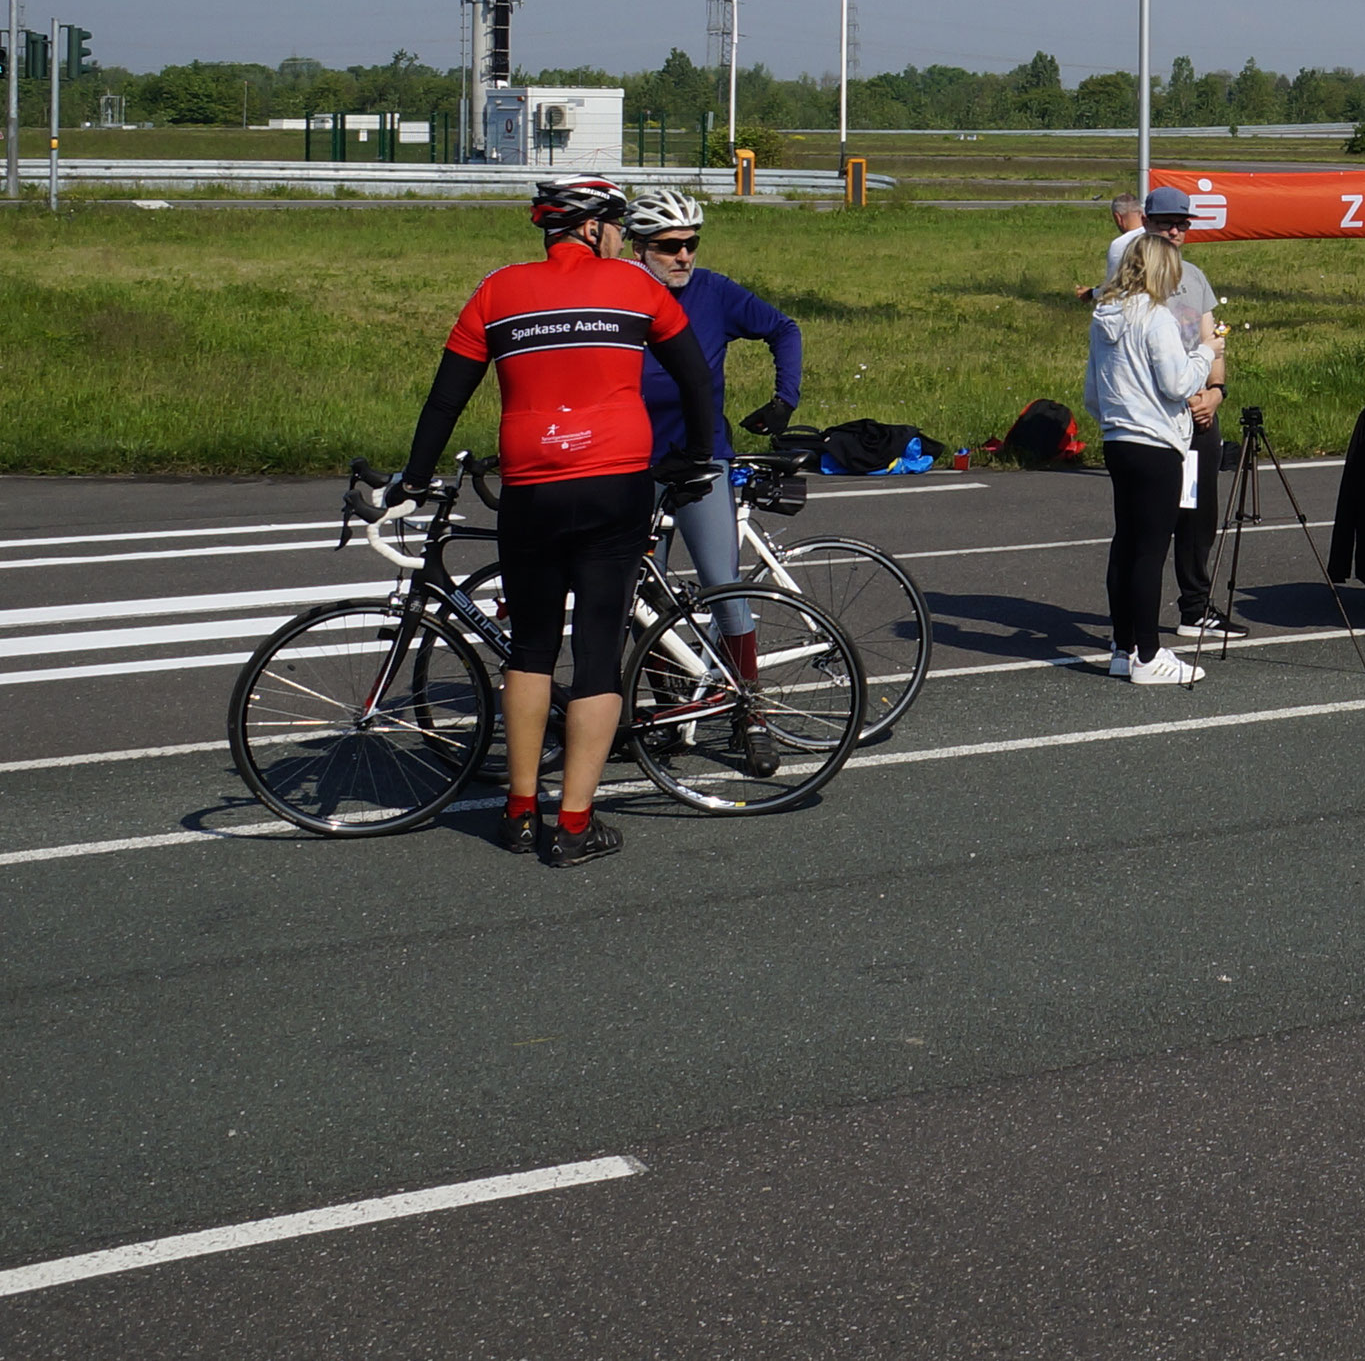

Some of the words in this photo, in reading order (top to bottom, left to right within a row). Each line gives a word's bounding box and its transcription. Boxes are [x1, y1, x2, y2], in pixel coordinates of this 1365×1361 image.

[511, 323, 571, 341] Sparkasse
[574, 320, 620, 333] Aachen
[450, 588, 512, 656] SIMPL
